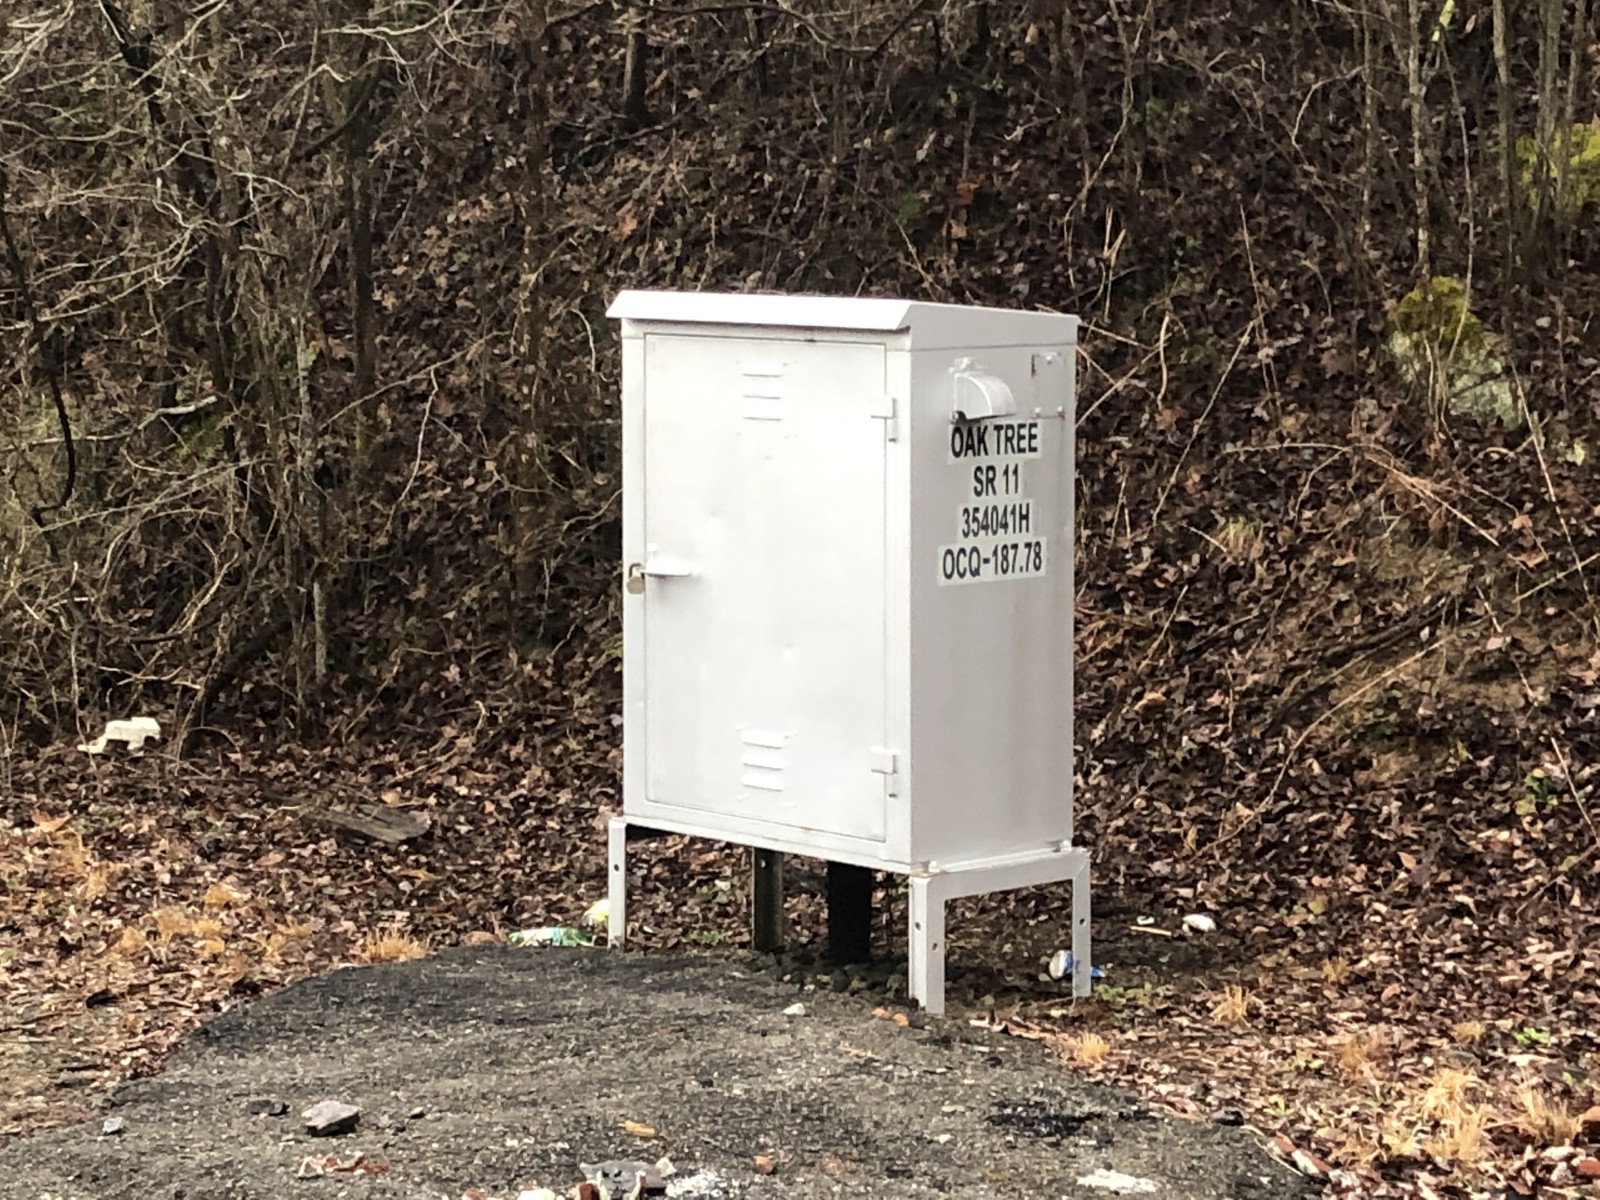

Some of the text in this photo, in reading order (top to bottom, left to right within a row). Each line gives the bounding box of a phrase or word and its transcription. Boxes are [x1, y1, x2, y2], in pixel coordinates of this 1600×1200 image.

[951, 422, 1038, 459] OAK TREE
[973, 463, 1019, 497] SR 11
[962, 502, 1030, 539] 354041H
[943, 541, 1042, 580] OCQ-187.78
